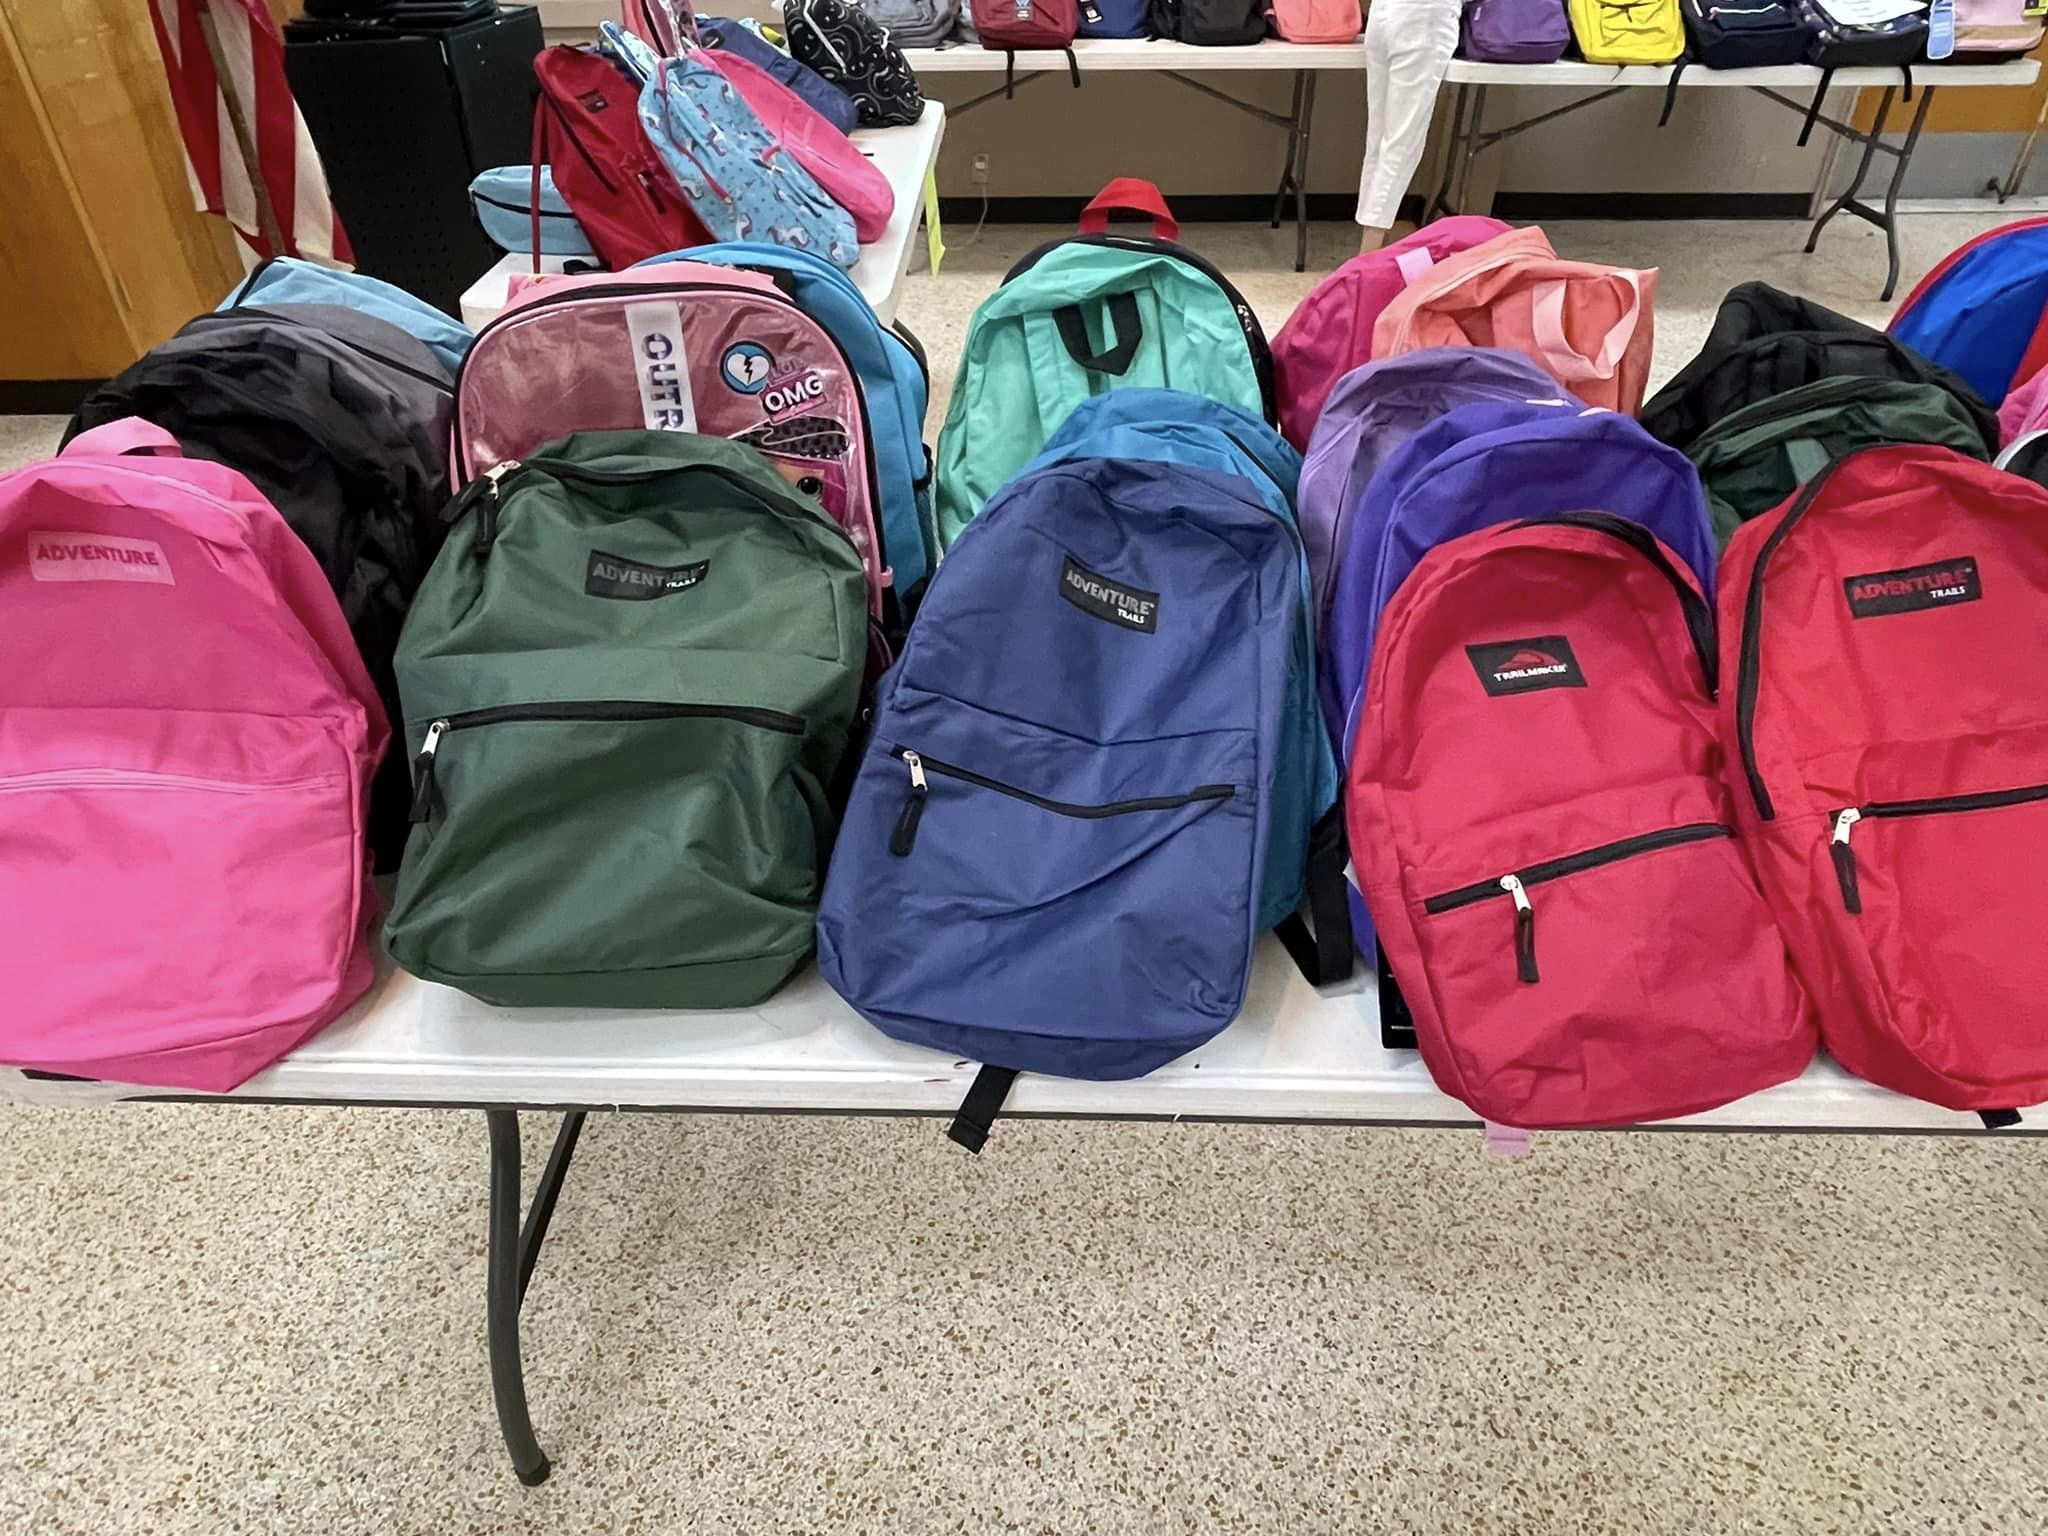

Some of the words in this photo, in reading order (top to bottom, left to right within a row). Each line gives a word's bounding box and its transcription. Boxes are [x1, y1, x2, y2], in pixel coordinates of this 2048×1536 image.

[765, 375, 823, 412] OMG
[37, 544, 159, 566] ADVENTURE
[1066, 569, 1150, 616] ADVENTURE
[1851, 569, 1969, 601] ADVENTURE
[1929, 585, 1966, 599] TRAILS
[1117, 608, 1145, 624] TRAILS
[1493, 663, 1567, 682] TRAILMAKER
